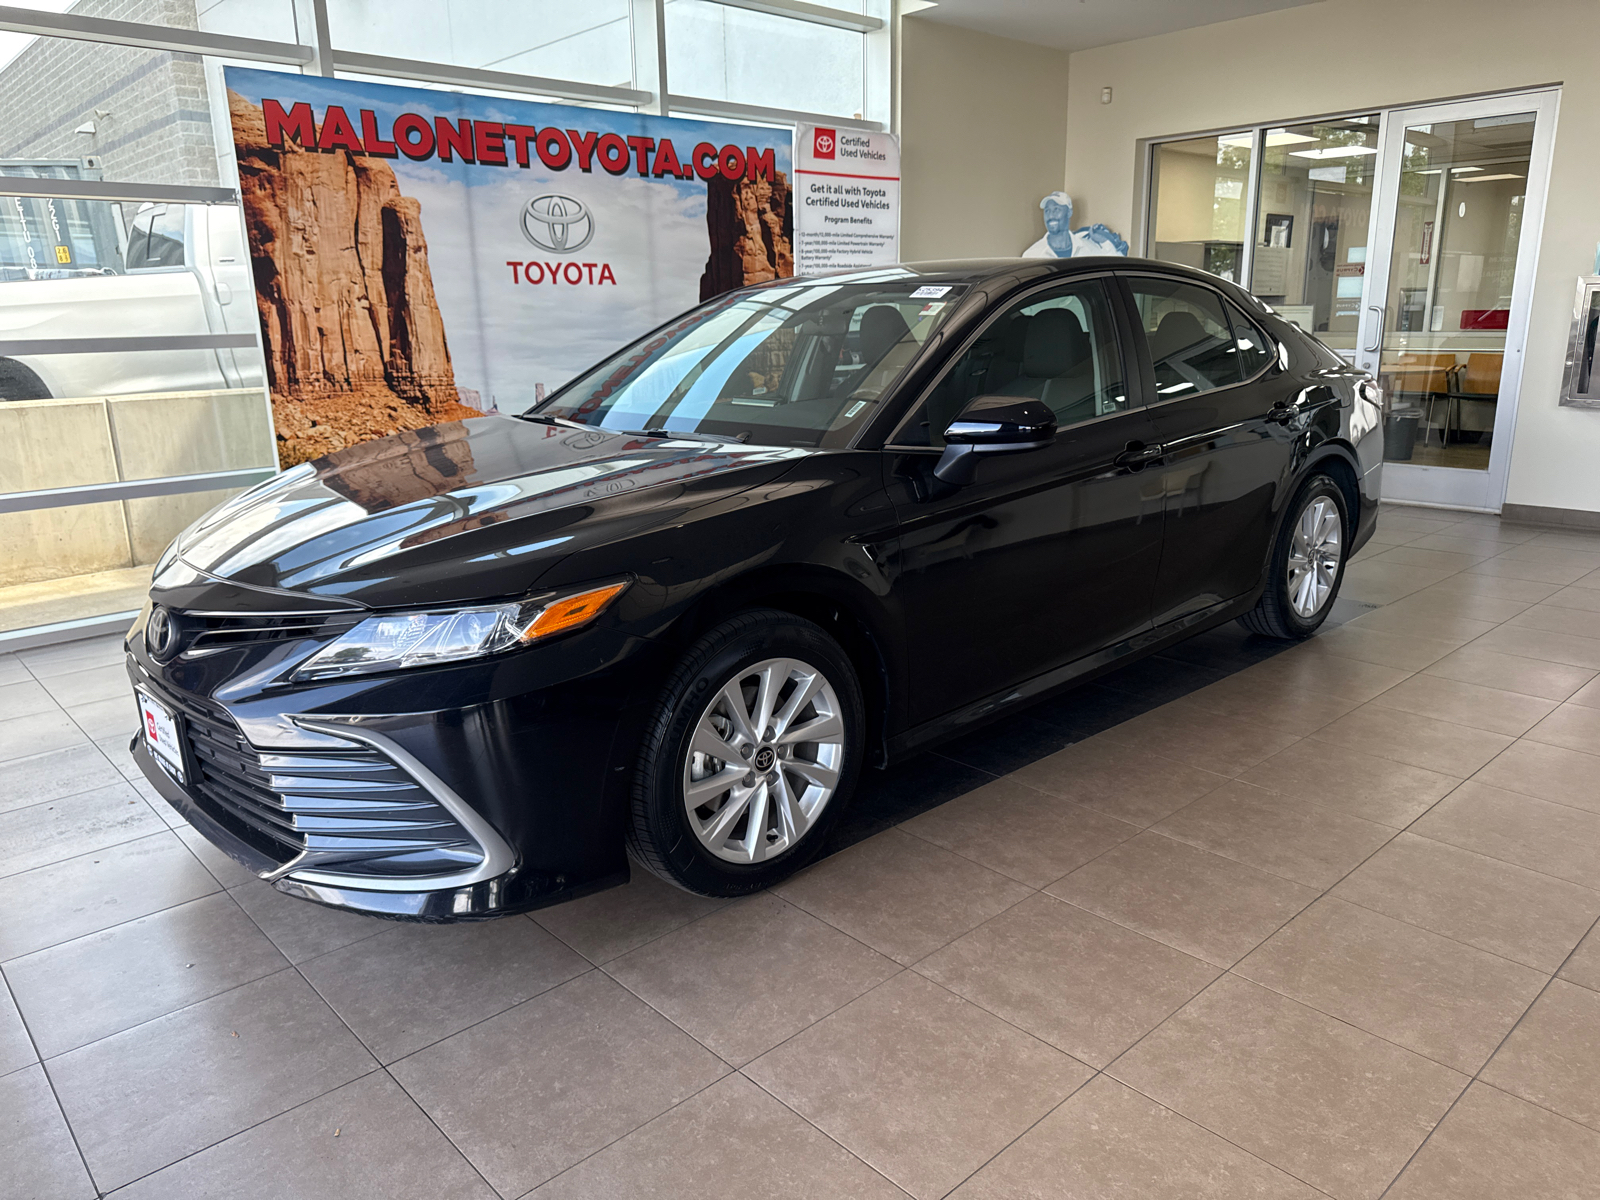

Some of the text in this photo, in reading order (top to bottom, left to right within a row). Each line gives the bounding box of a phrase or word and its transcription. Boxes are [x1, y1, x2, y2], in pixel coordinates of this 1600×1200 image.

[262, 98, 776, 182] MALONETOYOTA.COM
[840, 136, 870, 148] Certified
[840, 148, 886, 160] Used Vehicles
[810, 184, 886, 198] Get it all with Toyota
[806, 196, 889, 210] Certified Used Vehicles
[824, 216, 849, 225] Program
[506, 260, 617, 285] TOYOTA
